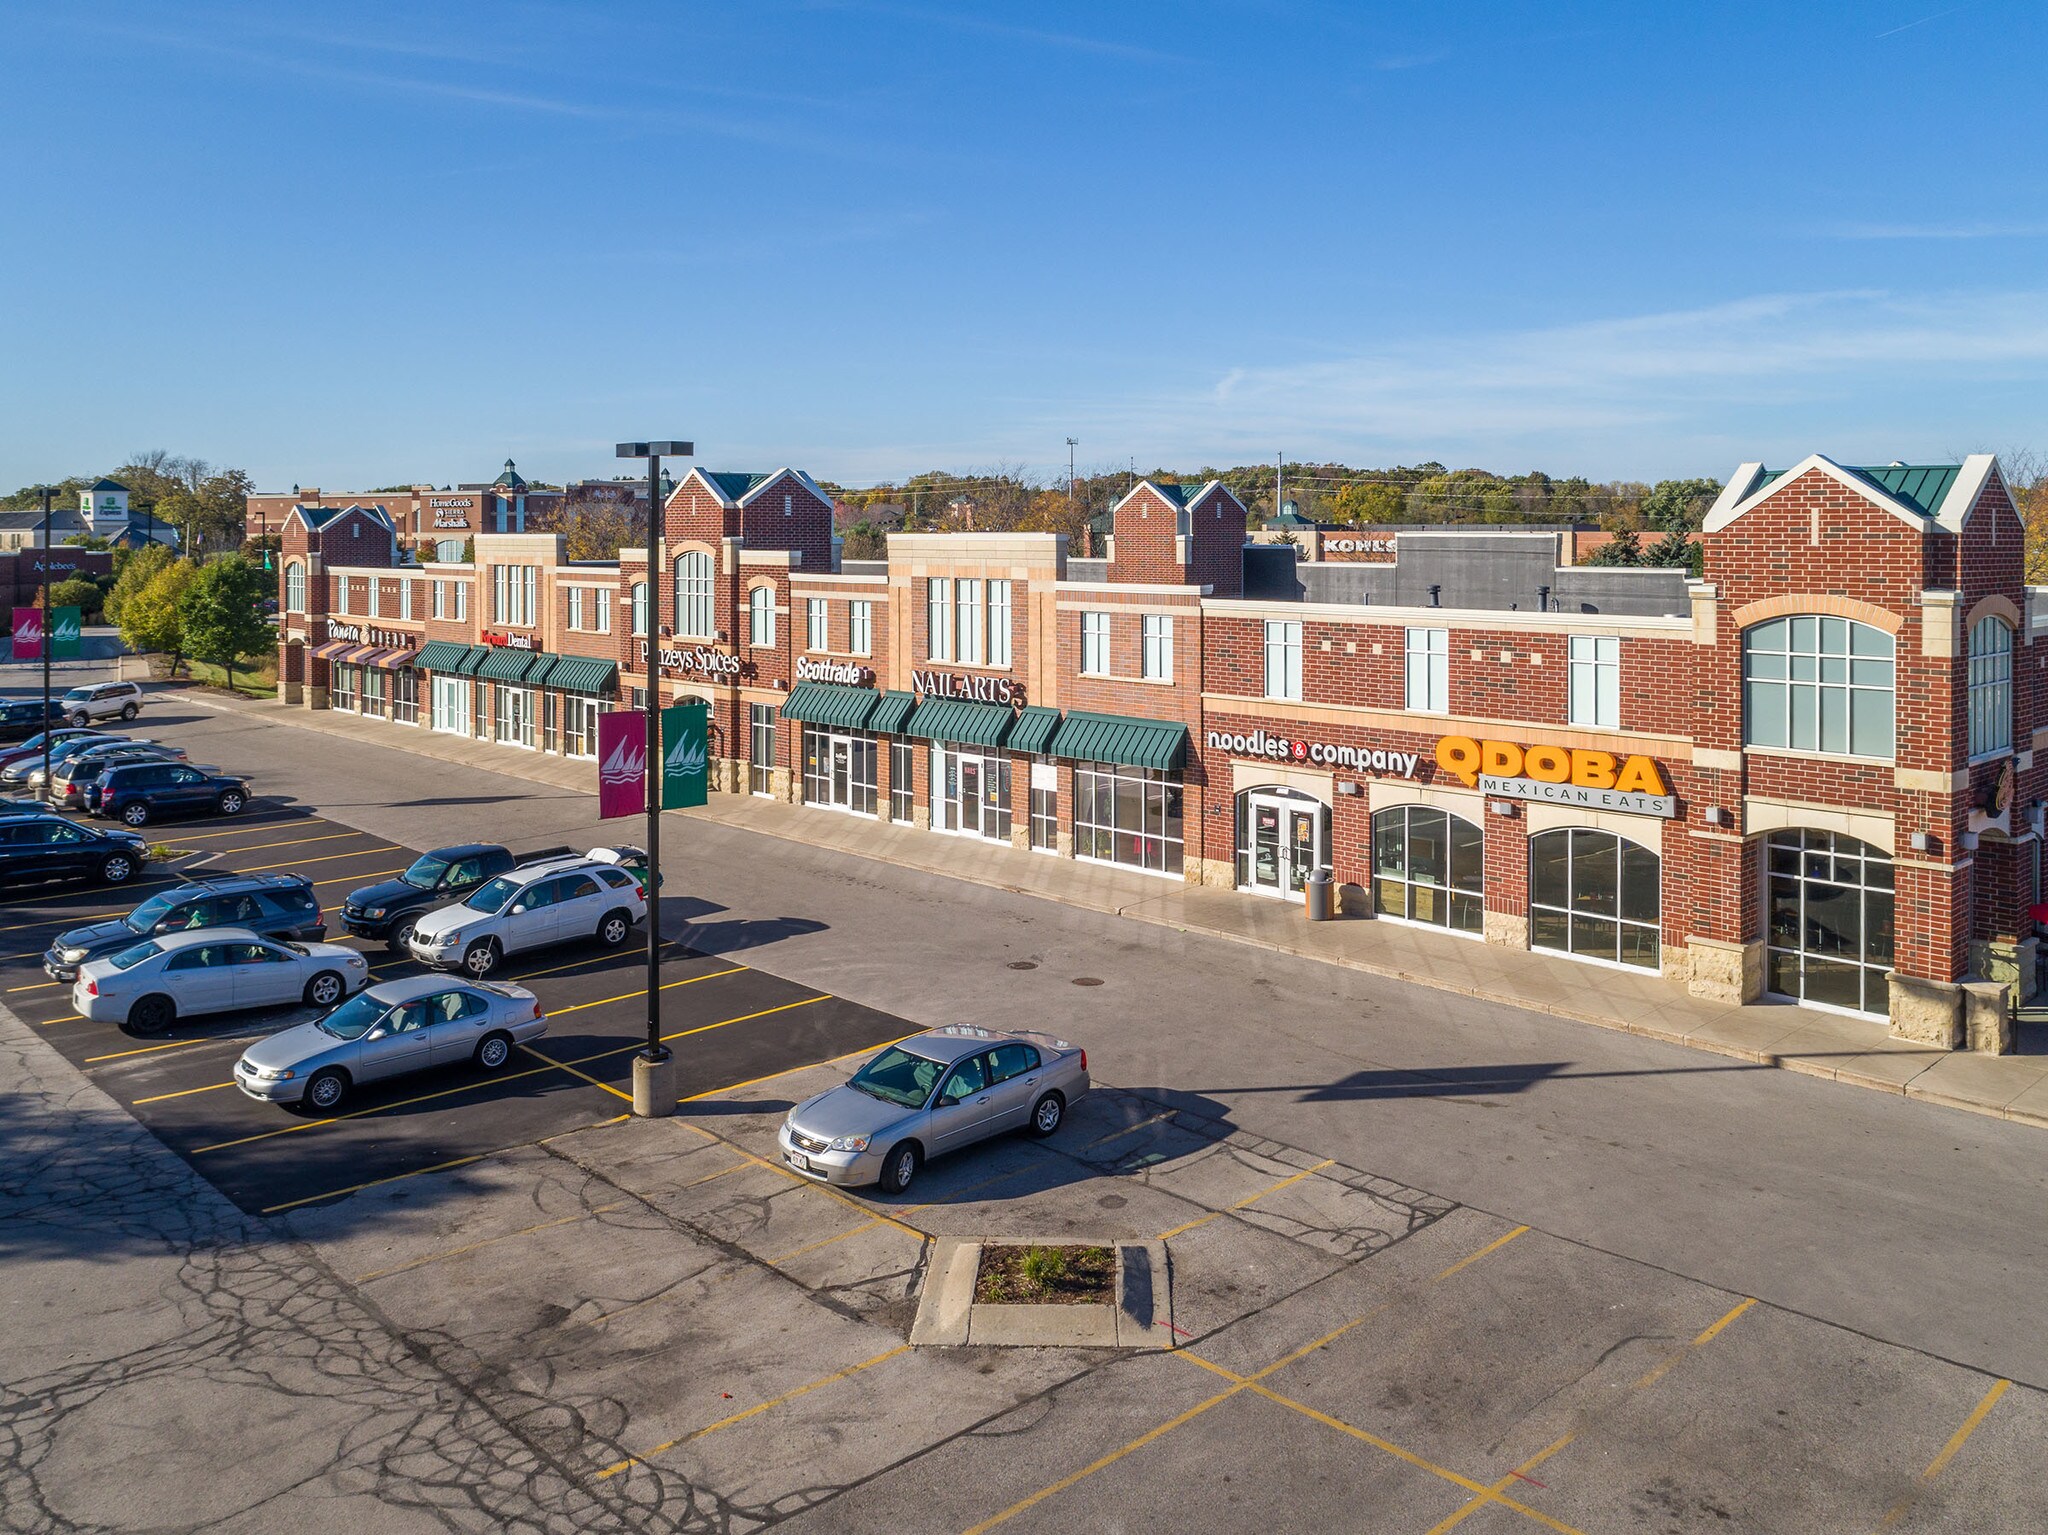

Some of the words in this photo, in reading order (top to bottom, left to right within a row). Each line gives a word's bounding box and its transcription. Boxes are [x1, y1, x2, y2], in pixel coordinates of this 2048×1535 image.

[429, 499, 472, 508] HomeGoods
[432, 518, 468, 528] Marshalls
[1323, 540, 1397, 552] KOHL'S
[327, 619, 359, 641] Panera
[640, 640, 694, 673] Pnzeys
[695, 645, 740, 676] Spices
[796, 656, 860, 685] Scottrade
[911, 670, 957, 698] NAIL
[960, 675, 1012, 704] ARTS
[1207, 730, 1290, 757] noodles
[1292, 740, 1308, 759] &
[1310, 742, 1420, 779] company
[1435, 735, 1668, 797] QDOBA
[1483, 779, 1589, 802] MEXICAN
